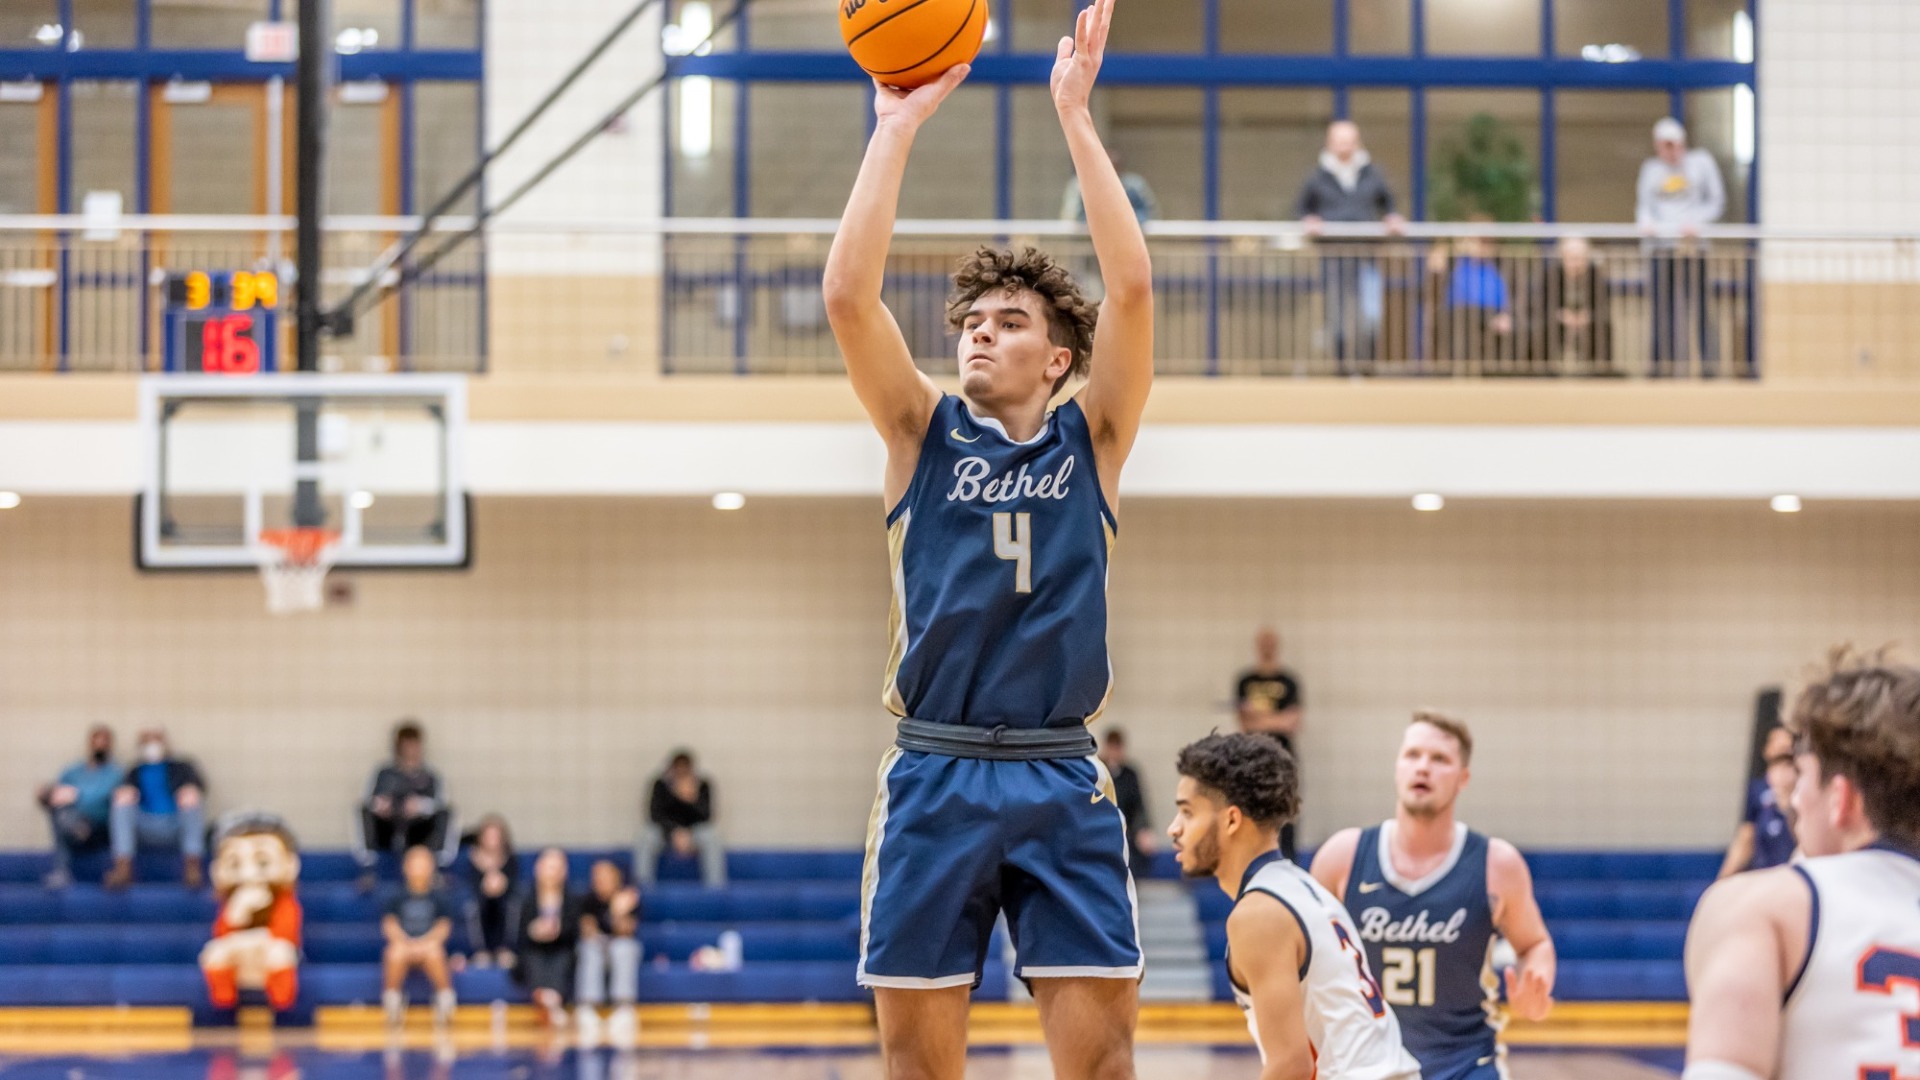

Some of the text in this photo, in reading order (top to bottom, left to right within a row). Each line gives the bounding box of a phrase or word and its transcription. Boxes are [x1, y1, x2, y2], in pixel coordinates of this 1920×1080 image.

[947, 455, 1075, 502] Bethel
[992, 512, 1032, 593] 4
[1360, 906, 1468, 943] Bethel
[1381, 947, 1437, 1007] 21
